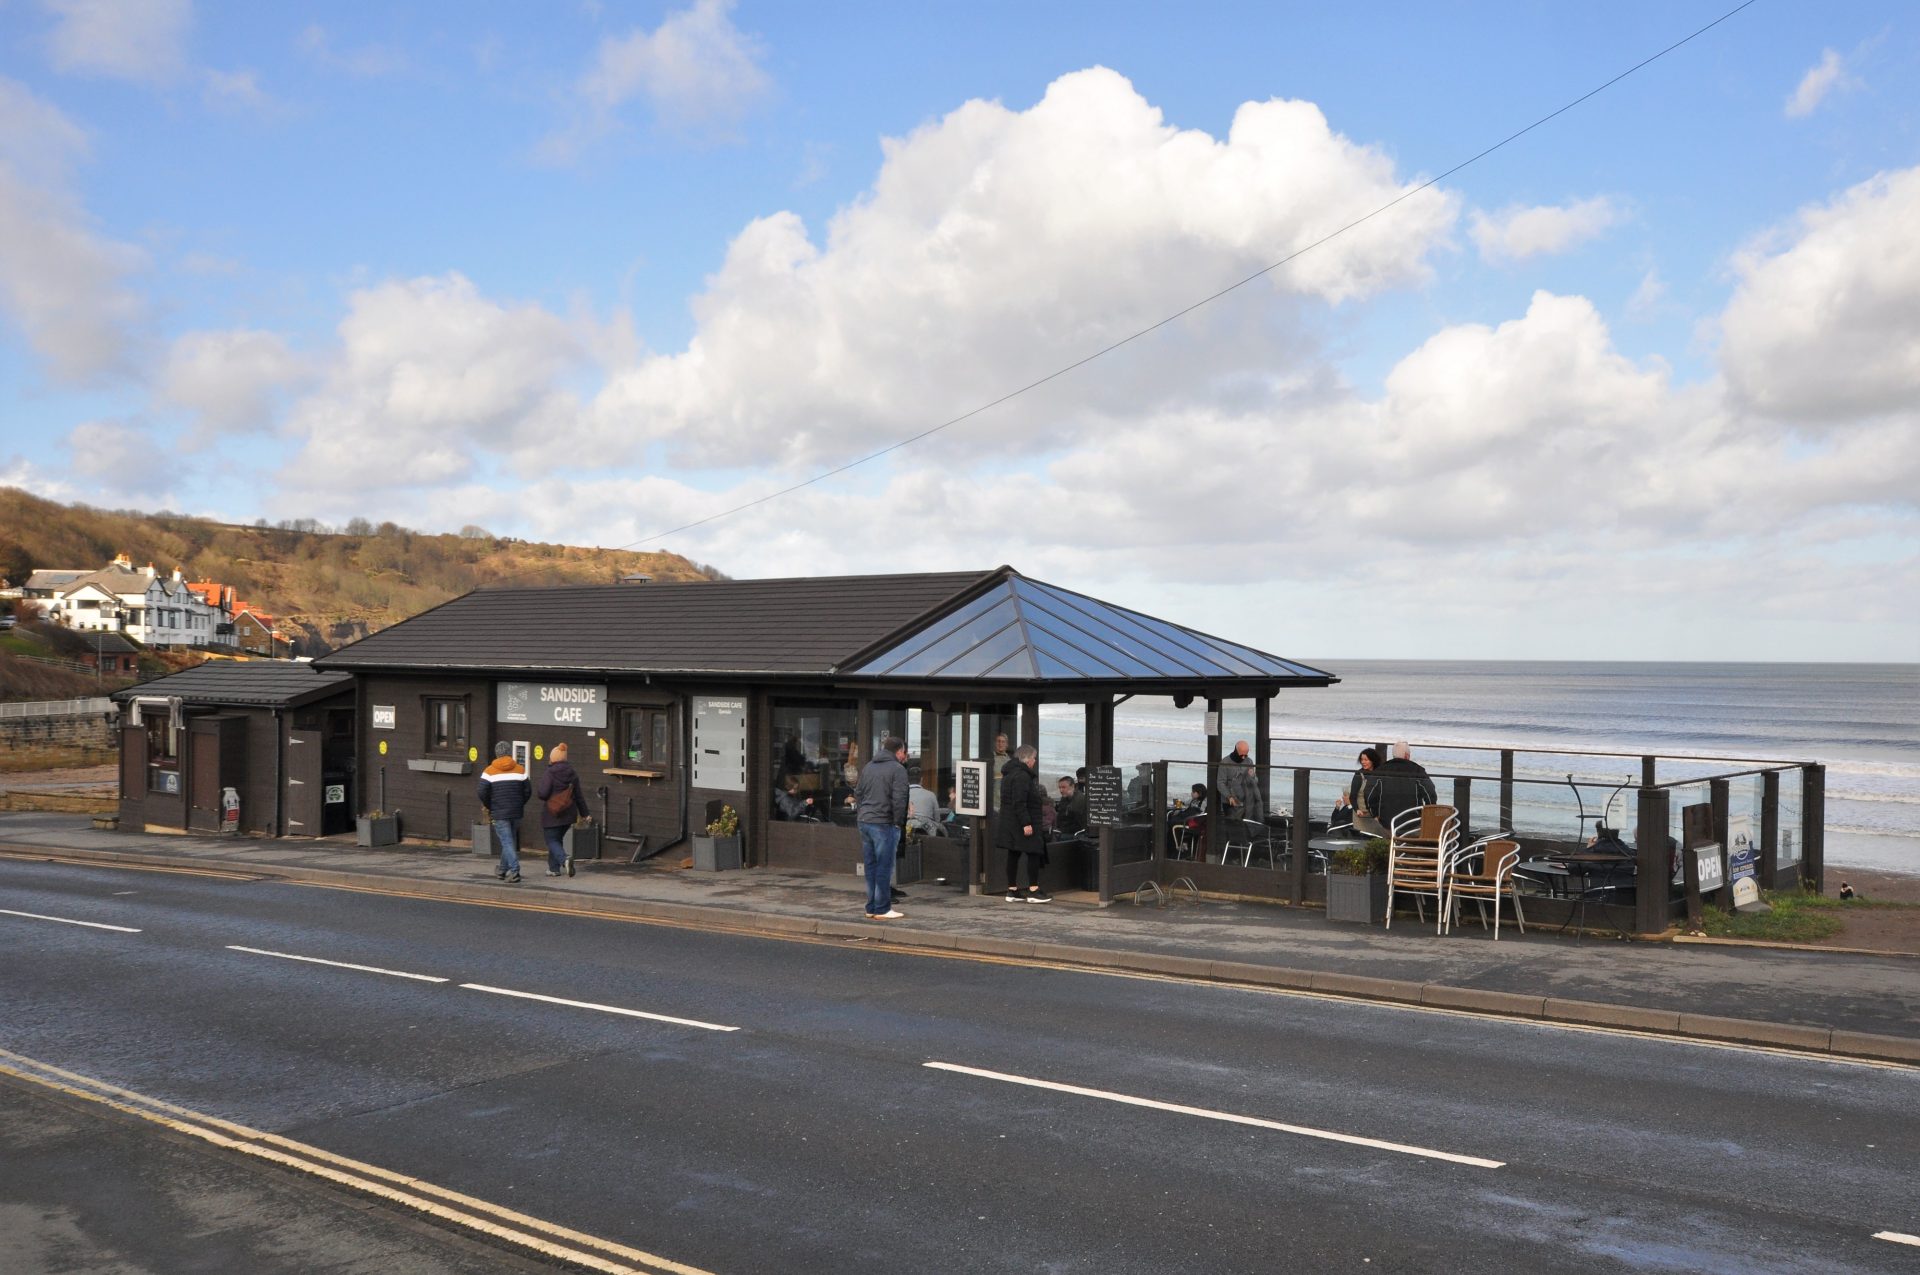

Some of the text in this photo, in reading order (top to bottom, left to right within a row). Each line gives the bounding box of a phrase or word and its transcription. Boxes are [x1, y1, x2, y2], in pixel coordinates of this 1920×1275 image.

[540, 687, 596, 703] SANDSIDE
[375, 711, 394, 723] OPEN
[554, 707, 582, 722] CAFE
[1697, 855, 1722, 882] OPEN
